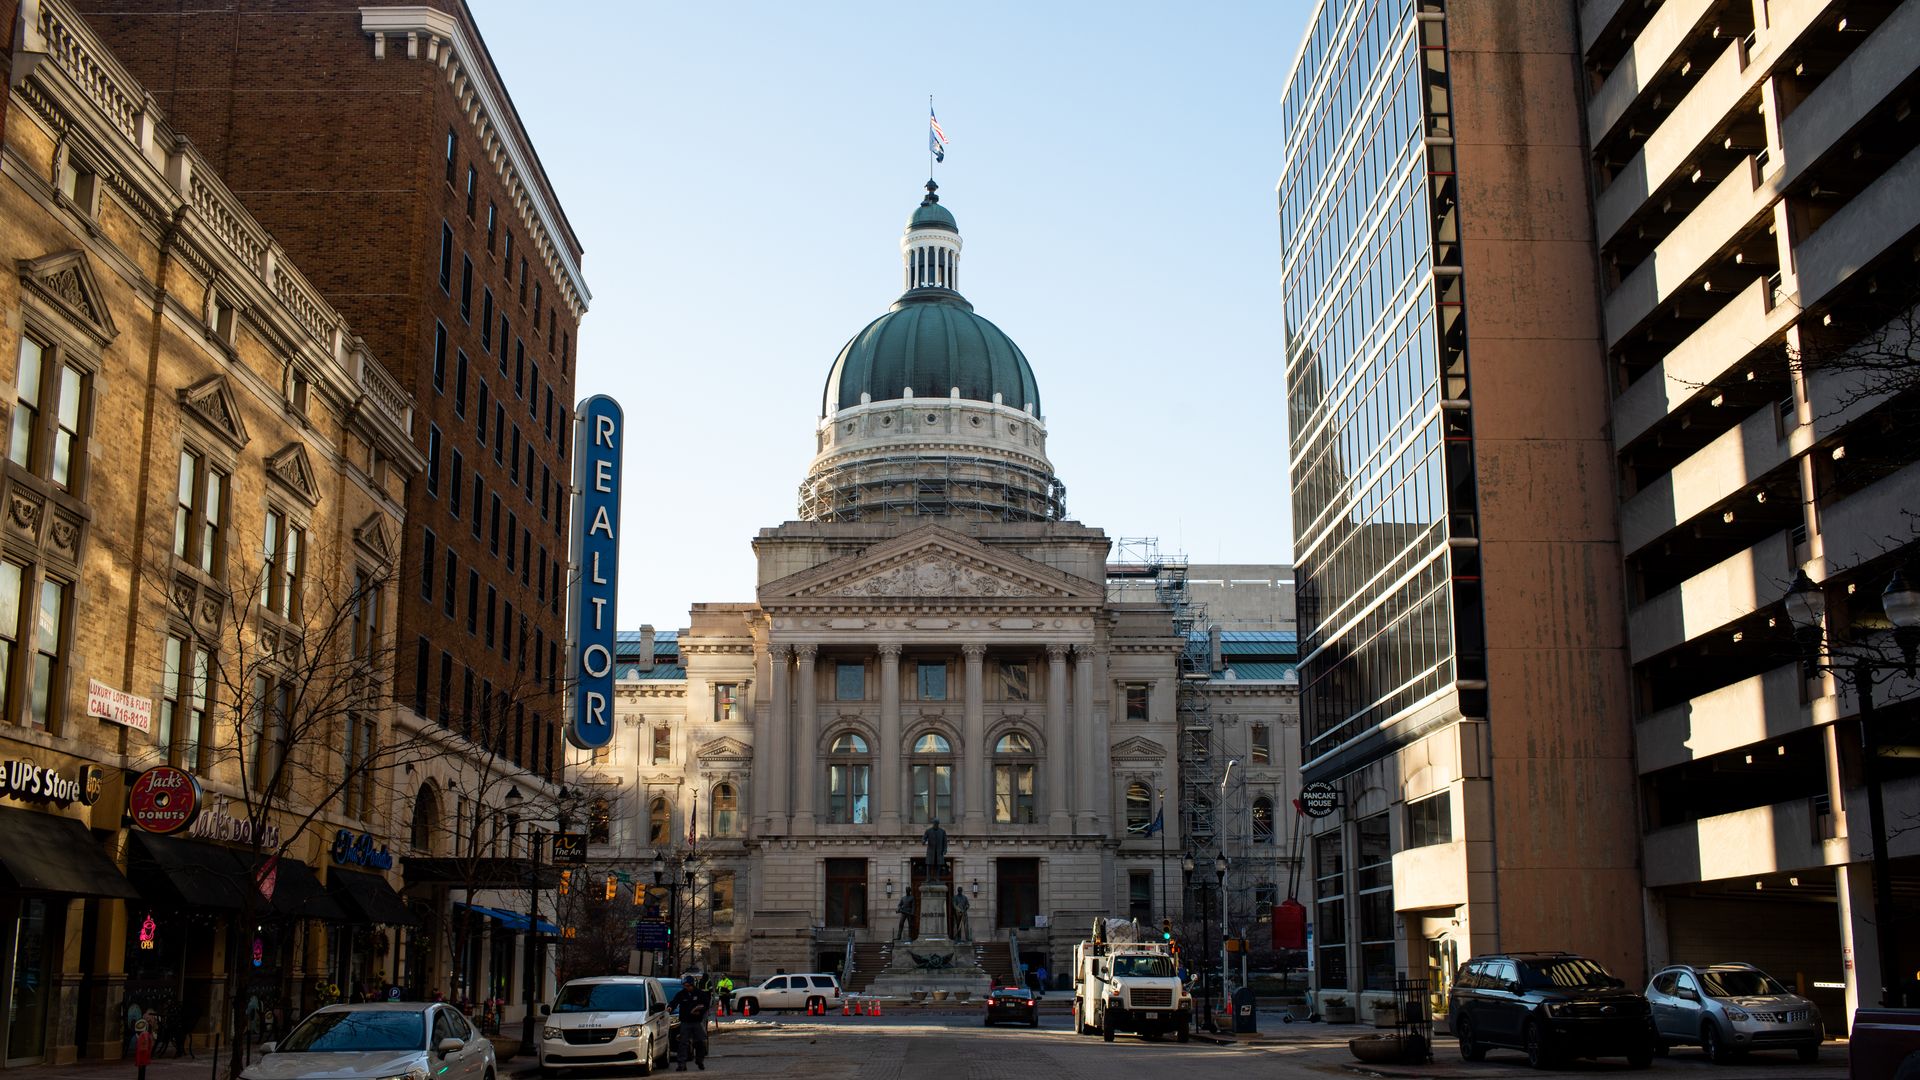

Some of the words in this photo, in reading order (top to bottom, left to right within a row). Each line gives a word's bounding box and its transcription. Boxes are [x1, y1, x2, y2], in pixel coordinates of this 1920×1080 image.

[583, 414, 615, 725] REALTOR
[90, 682, 112, 700] LUXURY
[113, 692, 130, 706] LOFTS
[130, 697, 135, 708] &
[136, 699, 151, 713] FLATS
[91, 699, 111, 718] CALL
[115, 707, 148, 729] 716-8128
[11, 761, 42, 794] UPS
[44, 768, 80, 802] Store
[145, 770, 183, 793] Jack's
[1307, 781, 1332, 791] LINCOLN
[1308, 799, 1332, 807] HOUSE
[138, 811, 185, 819] DONUTS
[1309, 807, 1331, 816] SQUARE
[554, 847, 569, 856] The
[140, 940, 154, 950] OPEN
